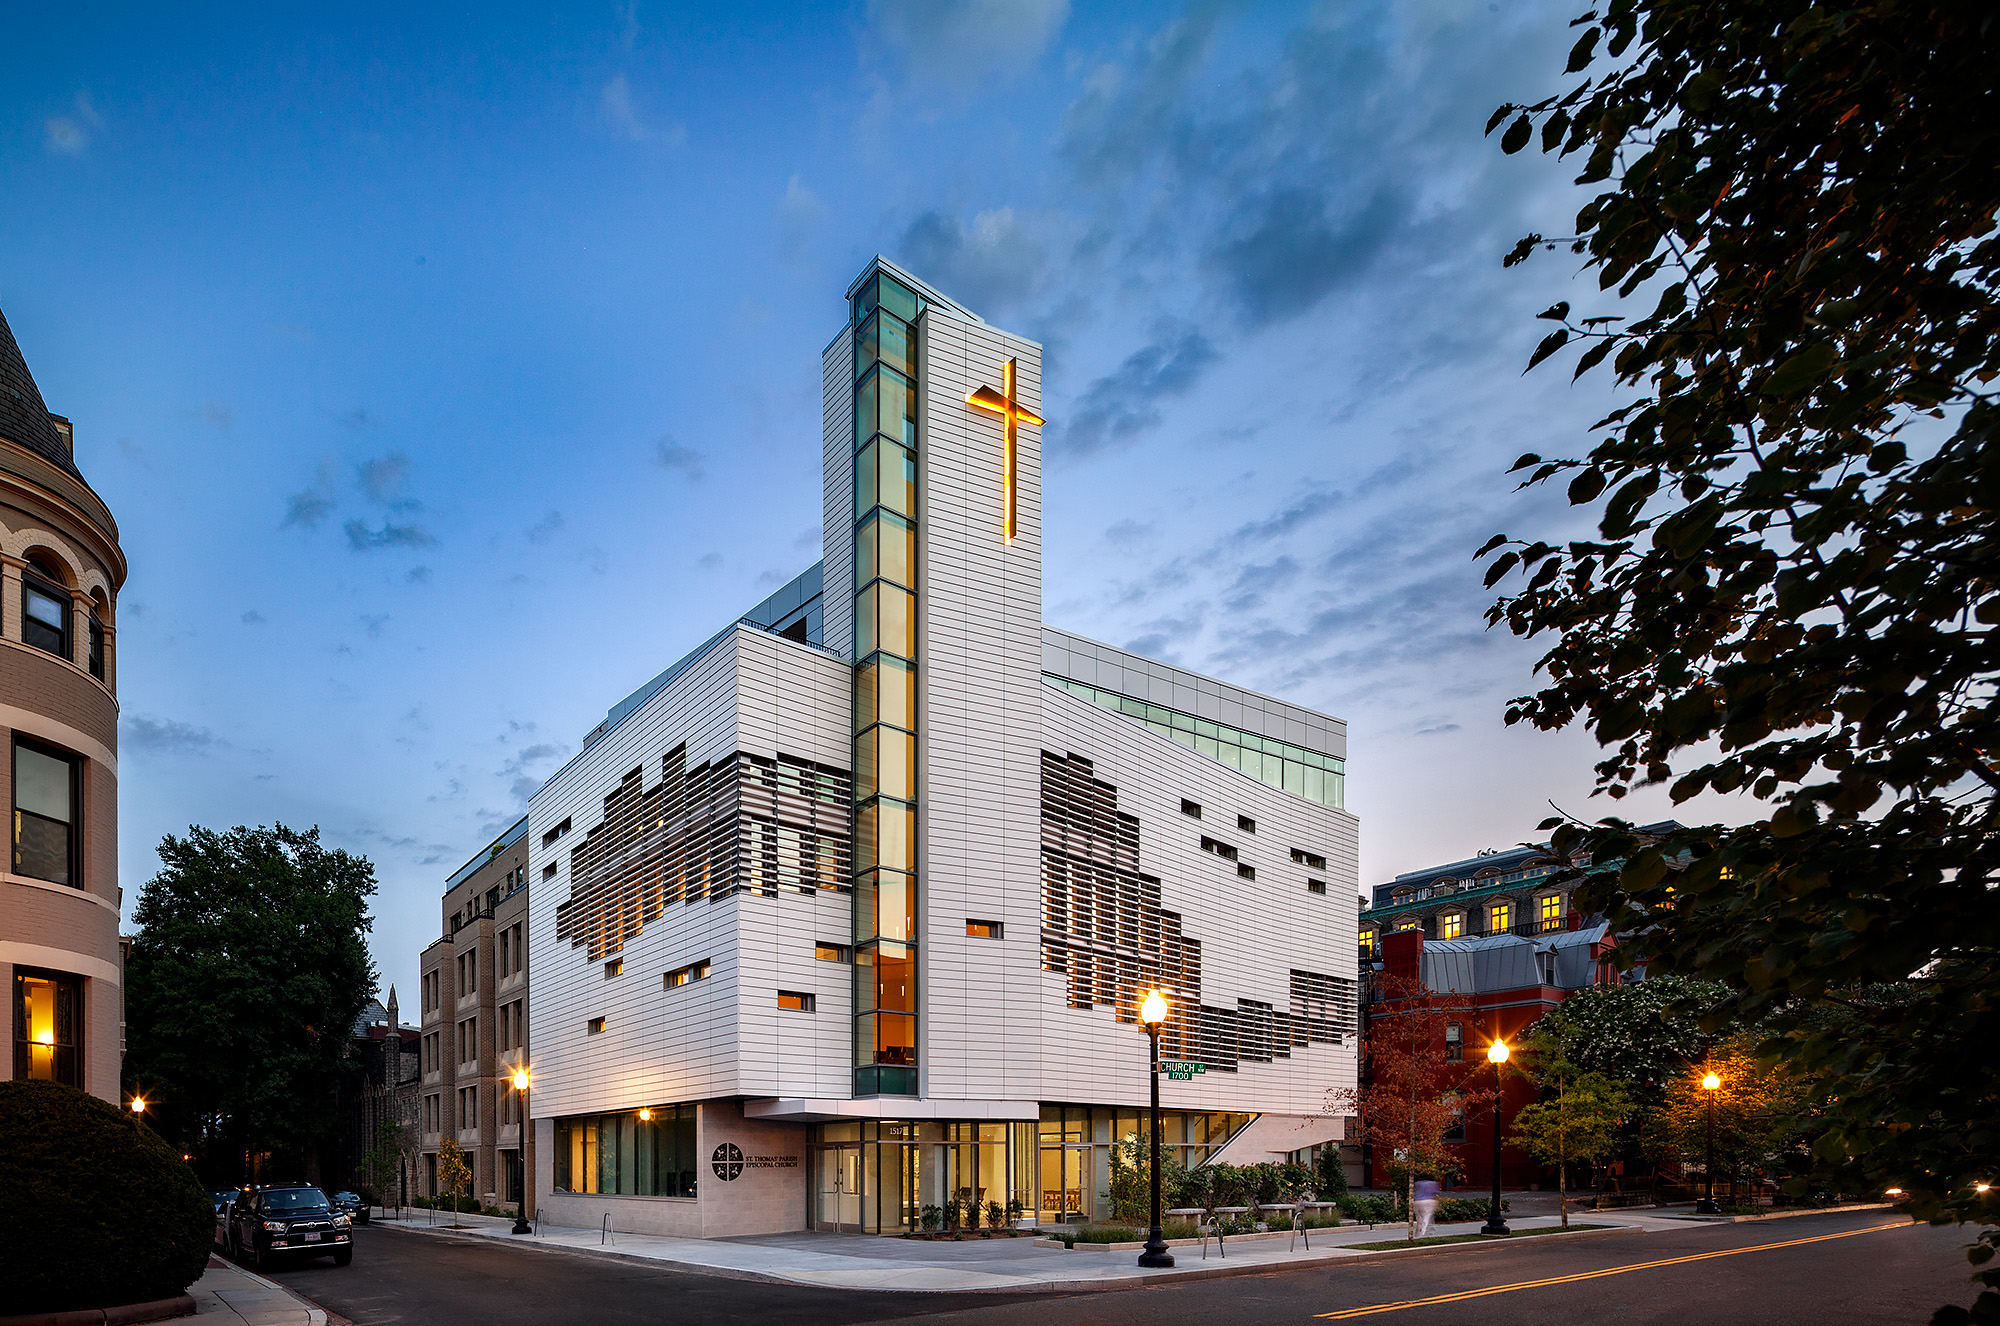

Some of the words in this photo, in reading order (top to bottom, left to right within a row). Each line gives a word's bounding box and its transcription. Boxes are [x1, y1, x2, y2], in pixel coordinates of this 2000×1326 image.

[1161, 1062, 1194, 1072] CHURCH
[1172, 1072, 1189, 1080] 1700
[890, 1127, 902, 1135] 1517
